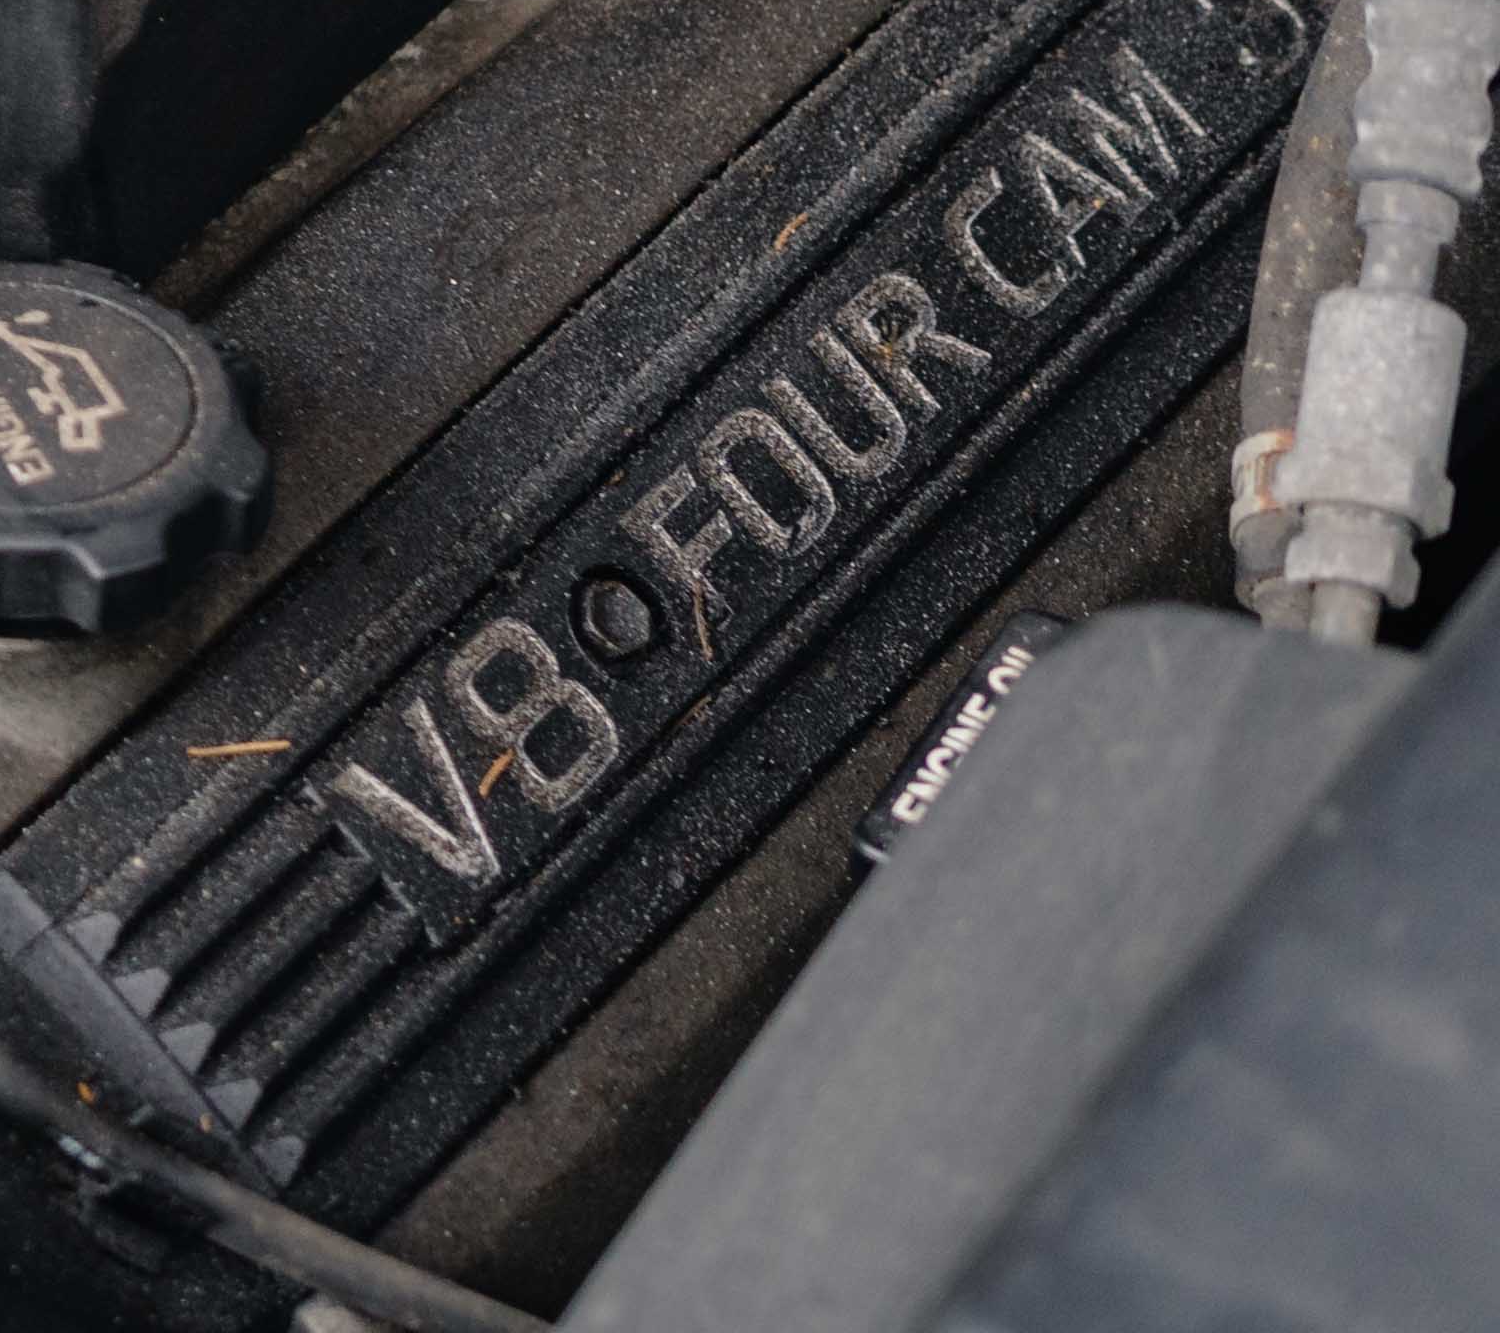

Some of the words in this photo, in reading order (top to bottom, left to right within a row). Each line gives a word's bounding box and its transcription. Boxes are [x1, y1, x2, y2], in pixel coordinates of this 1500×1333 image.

[334, 615, 620, 891] V8
[620, 272, 992, 631] FOUR
[943, 44, 1206, 319] CAM
